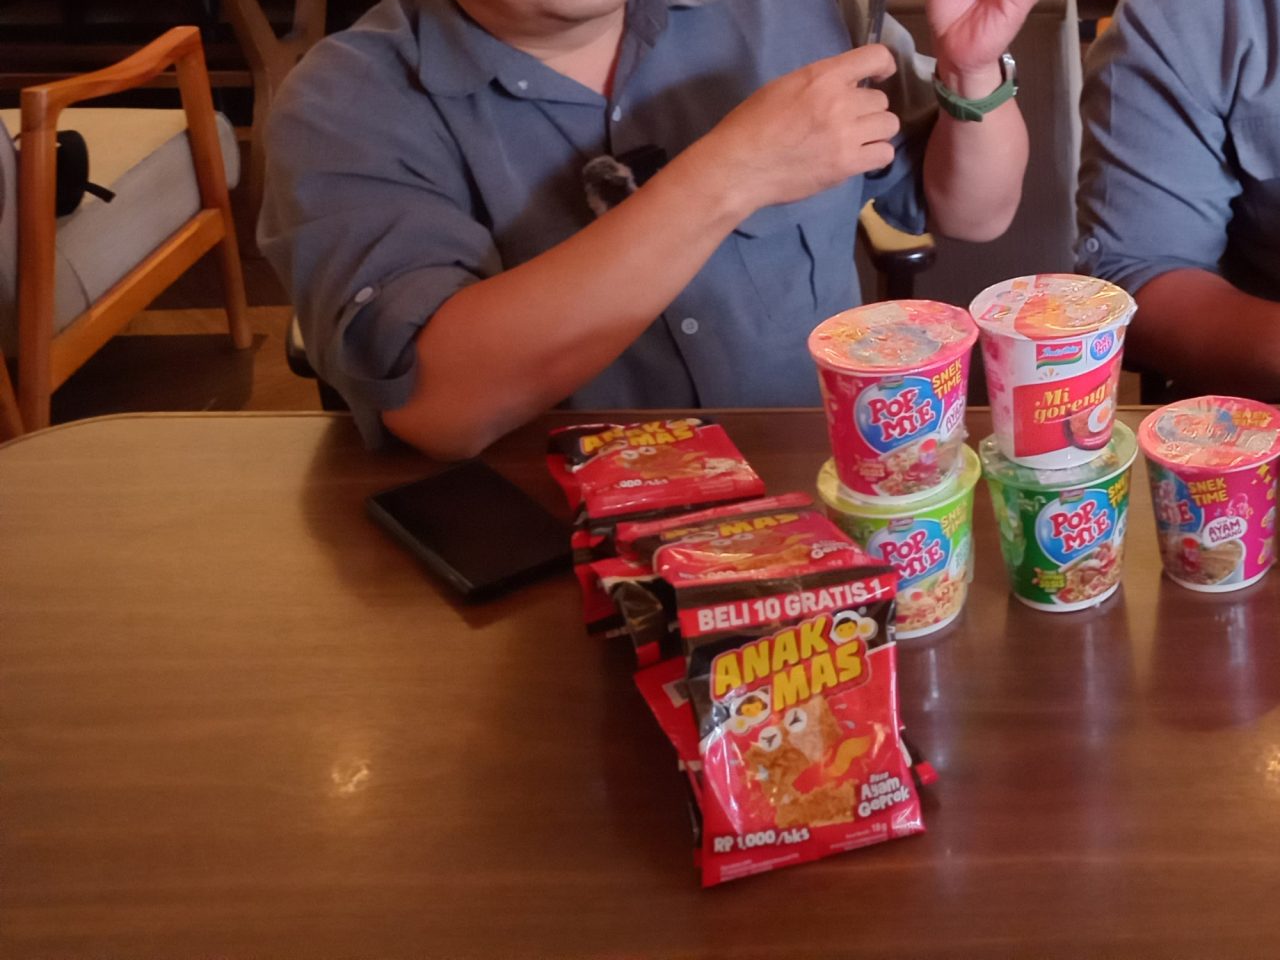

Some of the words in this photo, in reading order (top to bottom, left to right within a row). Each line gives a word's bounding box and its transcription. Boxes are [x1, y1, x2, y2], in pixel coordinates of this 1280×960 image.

[932, 358, 962, 388] SNEK
[934, 372, 962, 400] TIME
[1034, 384, 1106, 424] goreng
[1035, 386, 1069, 407] Mi
[881, 399, 936, 442] MIE
[1187, 477, 1227, 493] SNEK
[1191, 489, 1228, 506] TIME
[1049, 500, 1096, 538] POP
[1061, 509, 1111, 554] MIE
[1208, 519, 1241, 537] AYAM
[879, 530, 926, 564] POP
[895, 538, 945, 580] MIE
[697, 602, 750, 632] BELI
[753, 596, 782, 622] 10
[784, 583, 869, 617] GRATIS
[869, 578, 882, 600] 1
[715, 617, 829, 695] ANAK
[773, 641, 864, 712] MAS
[857, 786, 910, 817] Geprek
[861, 777, 901, 801] Ayam
[713, 837, 734, 853] RP
